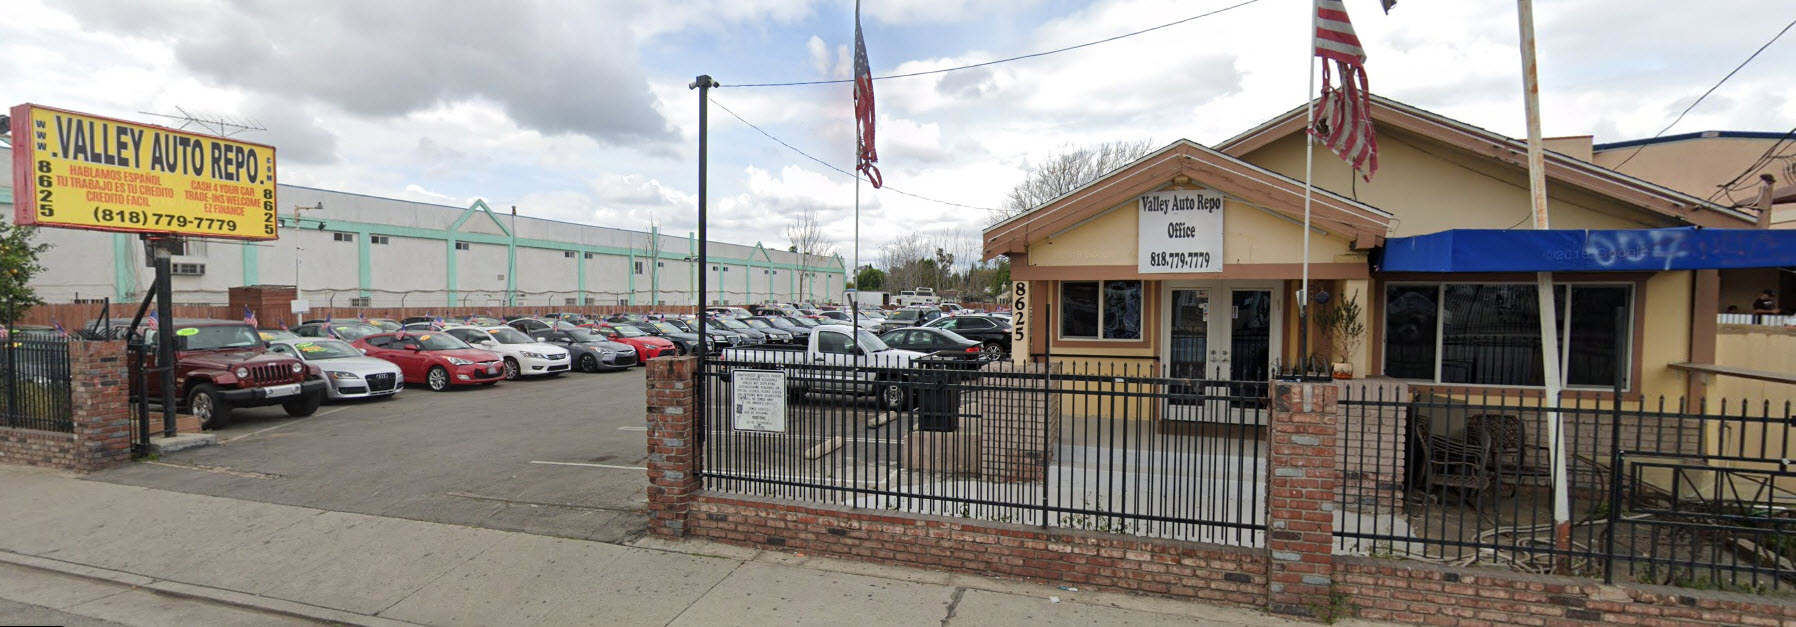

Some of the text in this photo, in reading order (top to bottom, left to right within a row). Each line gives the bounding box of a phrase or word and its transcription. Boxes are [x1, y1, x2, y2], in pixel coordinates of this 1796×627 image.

[151, 132, 204, 177] AUTO
[70, 165, 162, 186] HABLAMOS ESPAÑOL
[38, 160, 55, 217] 8625
[56, 175, 174, 198] TU TRABAJO ES TU CREDITO
[191, 180, 255, 197] CASH 4 YOUR CAR
[86, 191, 151, 207] CREDITO FACIL
[184, 190, 261, 208] TRADE-INS WELCOME
[1141, 193, 1221, 215] Valley Auto Repo
[93, 206, 237, 232] (818) 779-7779
[204, 203, 245, 217] EZ FINANCE
[263, 189, 274, 235] 8625
[1168, 222, 1196, 239] Office
[1150, 251, 1210, 269] 818.779.7779
[1014, 281, 1026, 342] 8625
